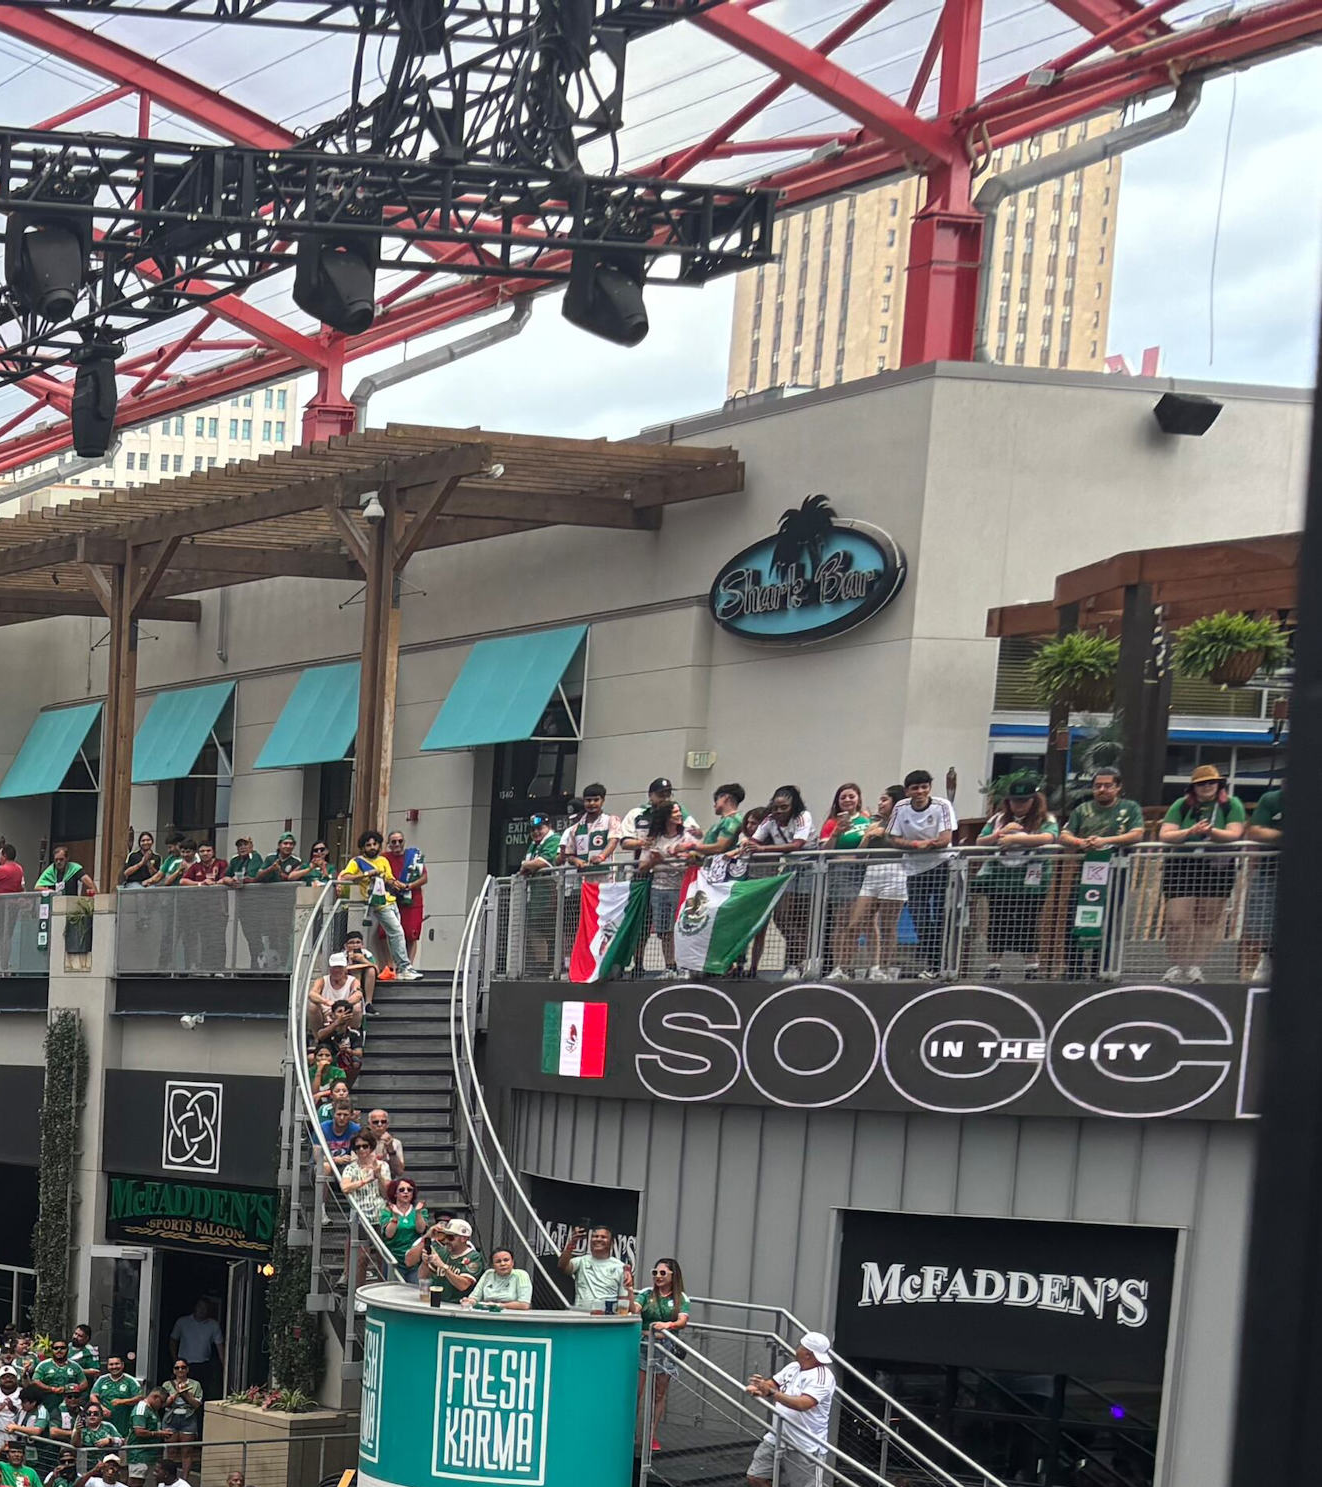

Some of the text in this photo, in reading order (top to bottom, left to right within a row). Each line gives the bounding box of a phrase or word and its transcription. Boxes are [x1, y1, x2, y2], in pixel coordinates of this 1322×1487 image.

[716, 549, 876, 621] Shark Bar
[930, 1040, 1154, 1061] IN THE CITY
[110, 1178, 276, 1241] McFADDEN'S
[148, 1219, 244, 1239] SPORTS SALOON
[857, 1261, 1149, 1328] McFADDEN'S
[446, 1345, 538, 1411] FRESH
[443, 1406, 534, 1473] KARMA
